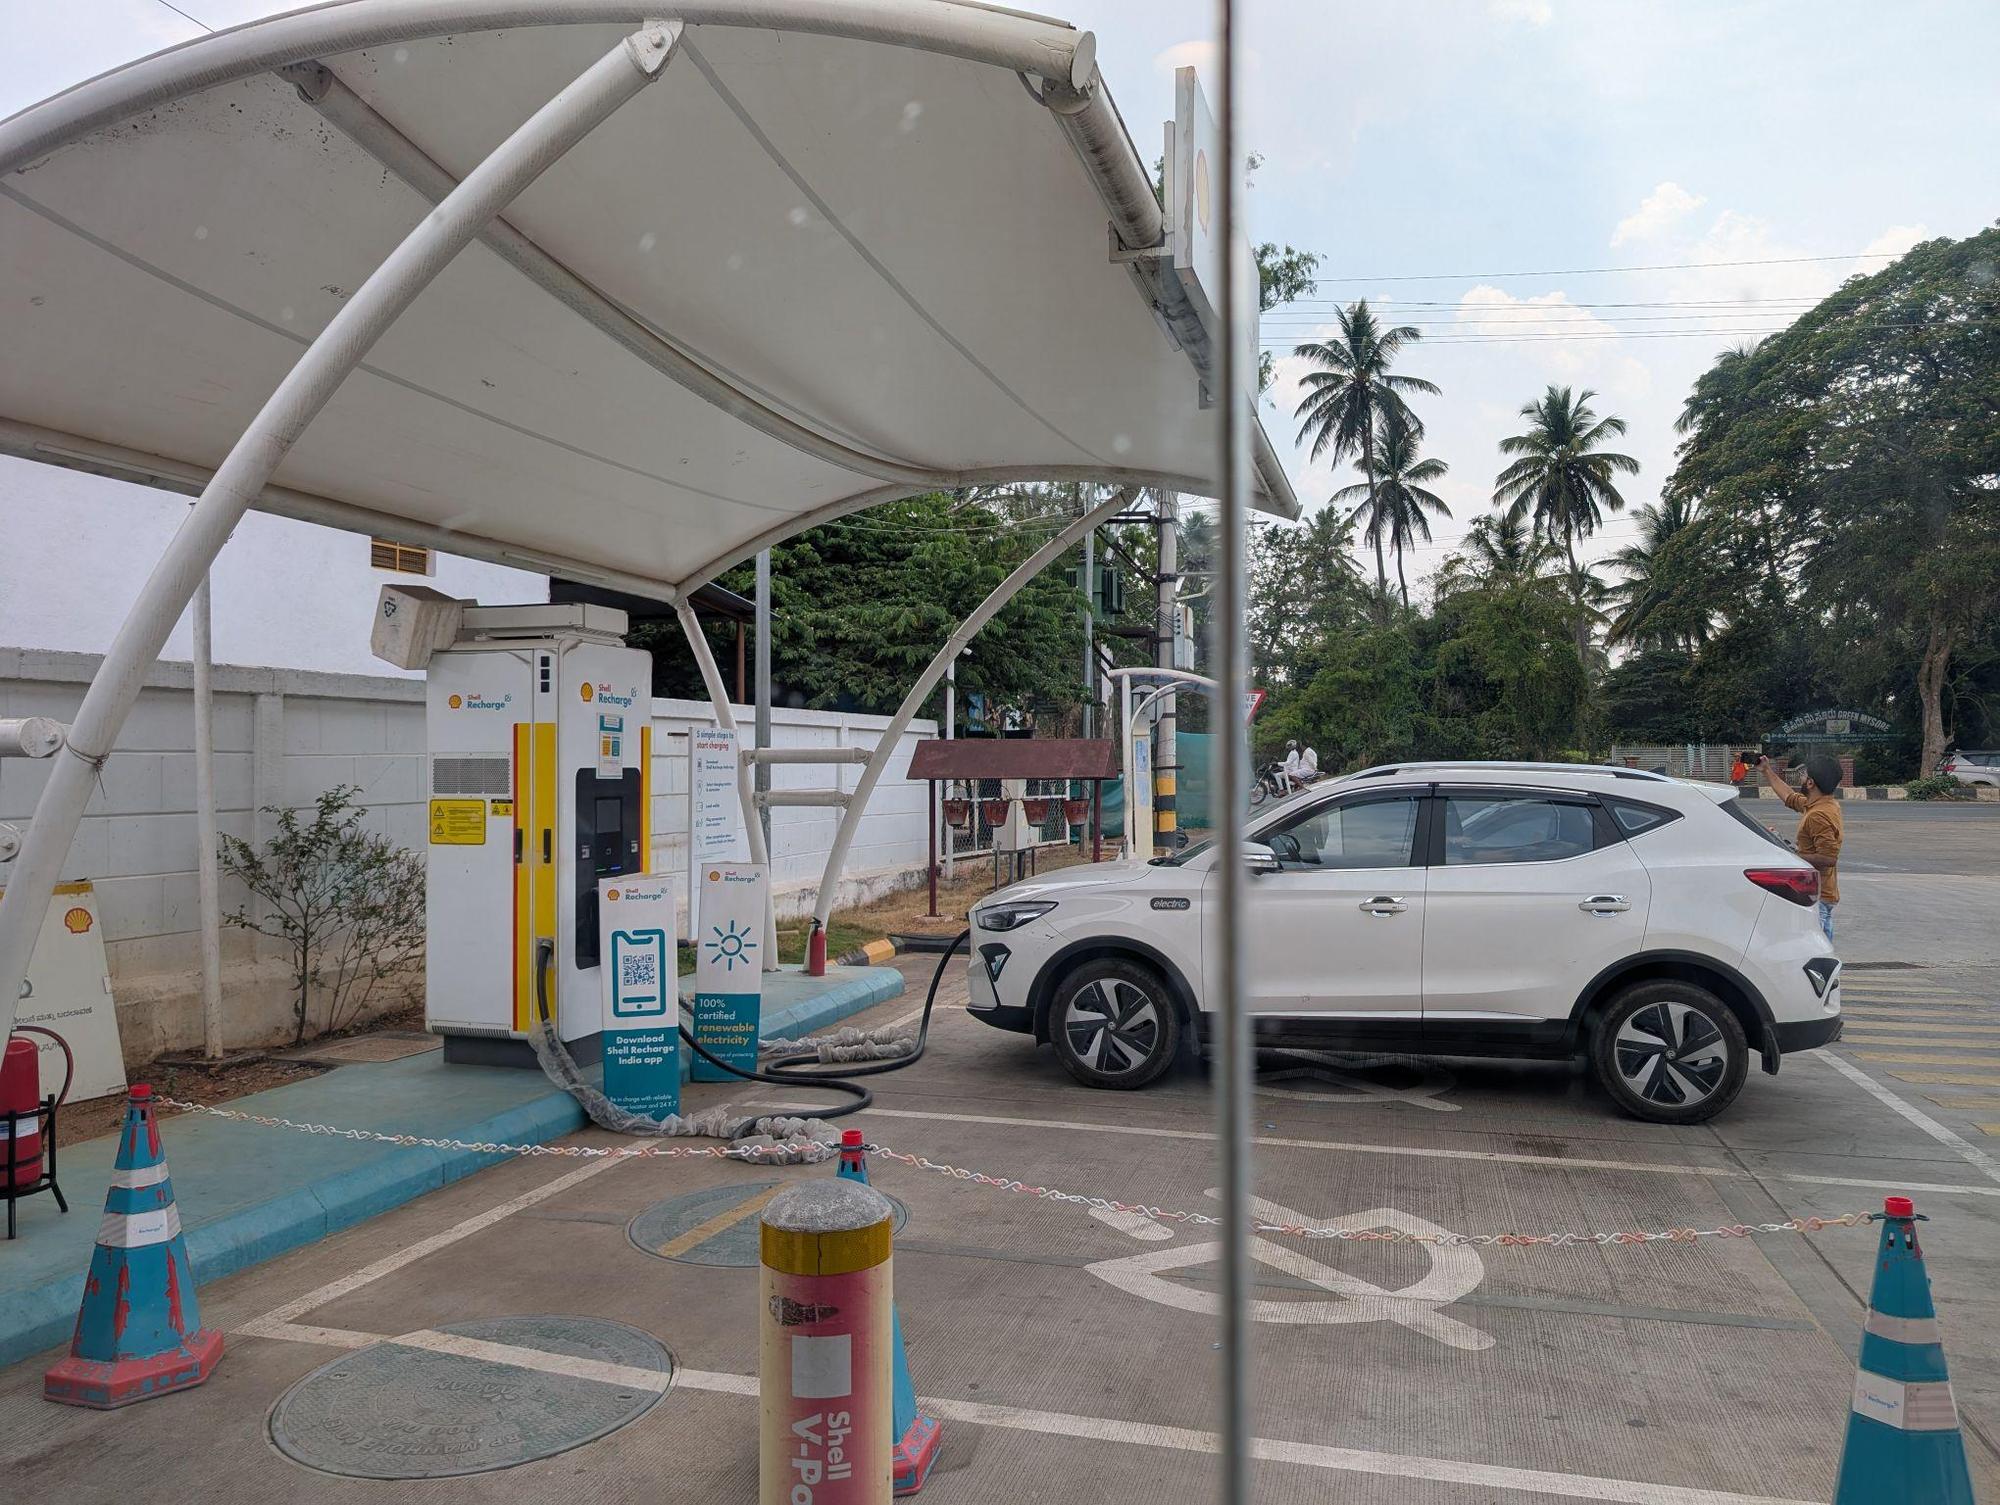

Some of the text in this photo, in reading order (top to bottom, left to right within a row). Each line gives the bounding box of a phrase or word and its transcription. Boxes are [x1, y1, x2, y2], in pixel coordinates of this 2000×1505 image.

[598, 684, 611, 692] Shell
[598, 692, 632, 708] Recharge
[467, 700, 506, 711] Recharge
[1837, 710, 1890, 732] GREEN MYSORE
[701, 731, 716, 740] simple
[709, 743, 729, 751] charging
[1153, 898, 1187, 908] electric
[699, 998, 726, 1008] 100%
[698, 1011, 736, 1020] certified
[698, 1022, 755, 1032] renewable
[616, 1034, 664, 1044] Download
[698, 1036, 750, 1046] electricity
[608, 1045, 674, 1054] Shell Recharge
[618, 1056, 663, 1065] India app
[828, 1412, 851, 1480] Shell
